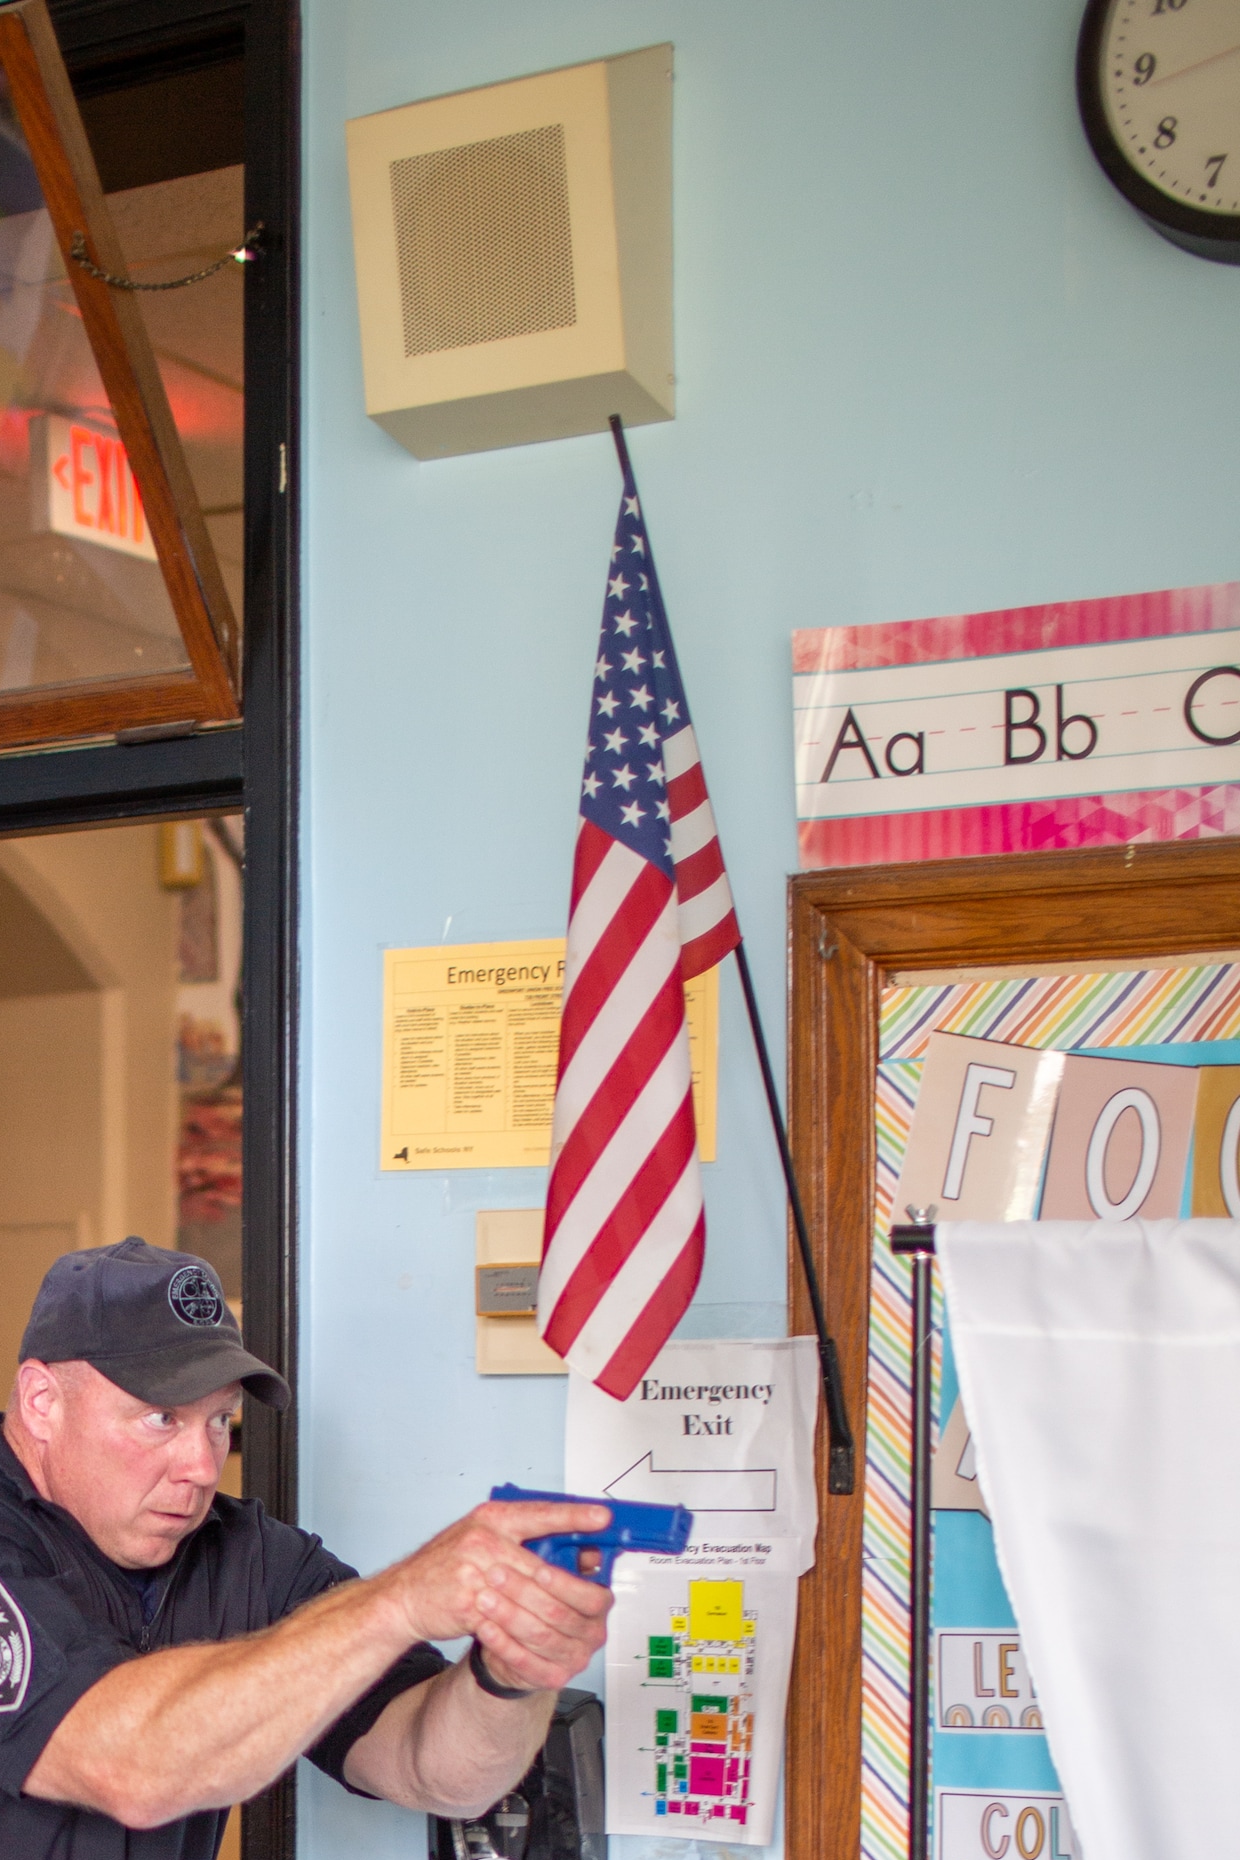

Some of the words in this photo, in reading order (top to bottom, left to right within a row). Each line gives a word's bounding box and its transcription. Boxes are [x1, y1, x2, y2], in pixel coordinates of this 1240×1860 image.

[1132, 52, 1157, 87] 9
[1153, 115, 1178, 150] 8
[1204, 153, 1229, 189] 7
[820, 706, 926, 783] Aa
[1003, 681, 1099, 767] Bb
[446, 963, 551, 987] Emergency
[639, 1378, 777, 1407] Emergency
[681, 1413, 734, 1437] Exit
[702, 1542, 752, 1554] Evacuation
